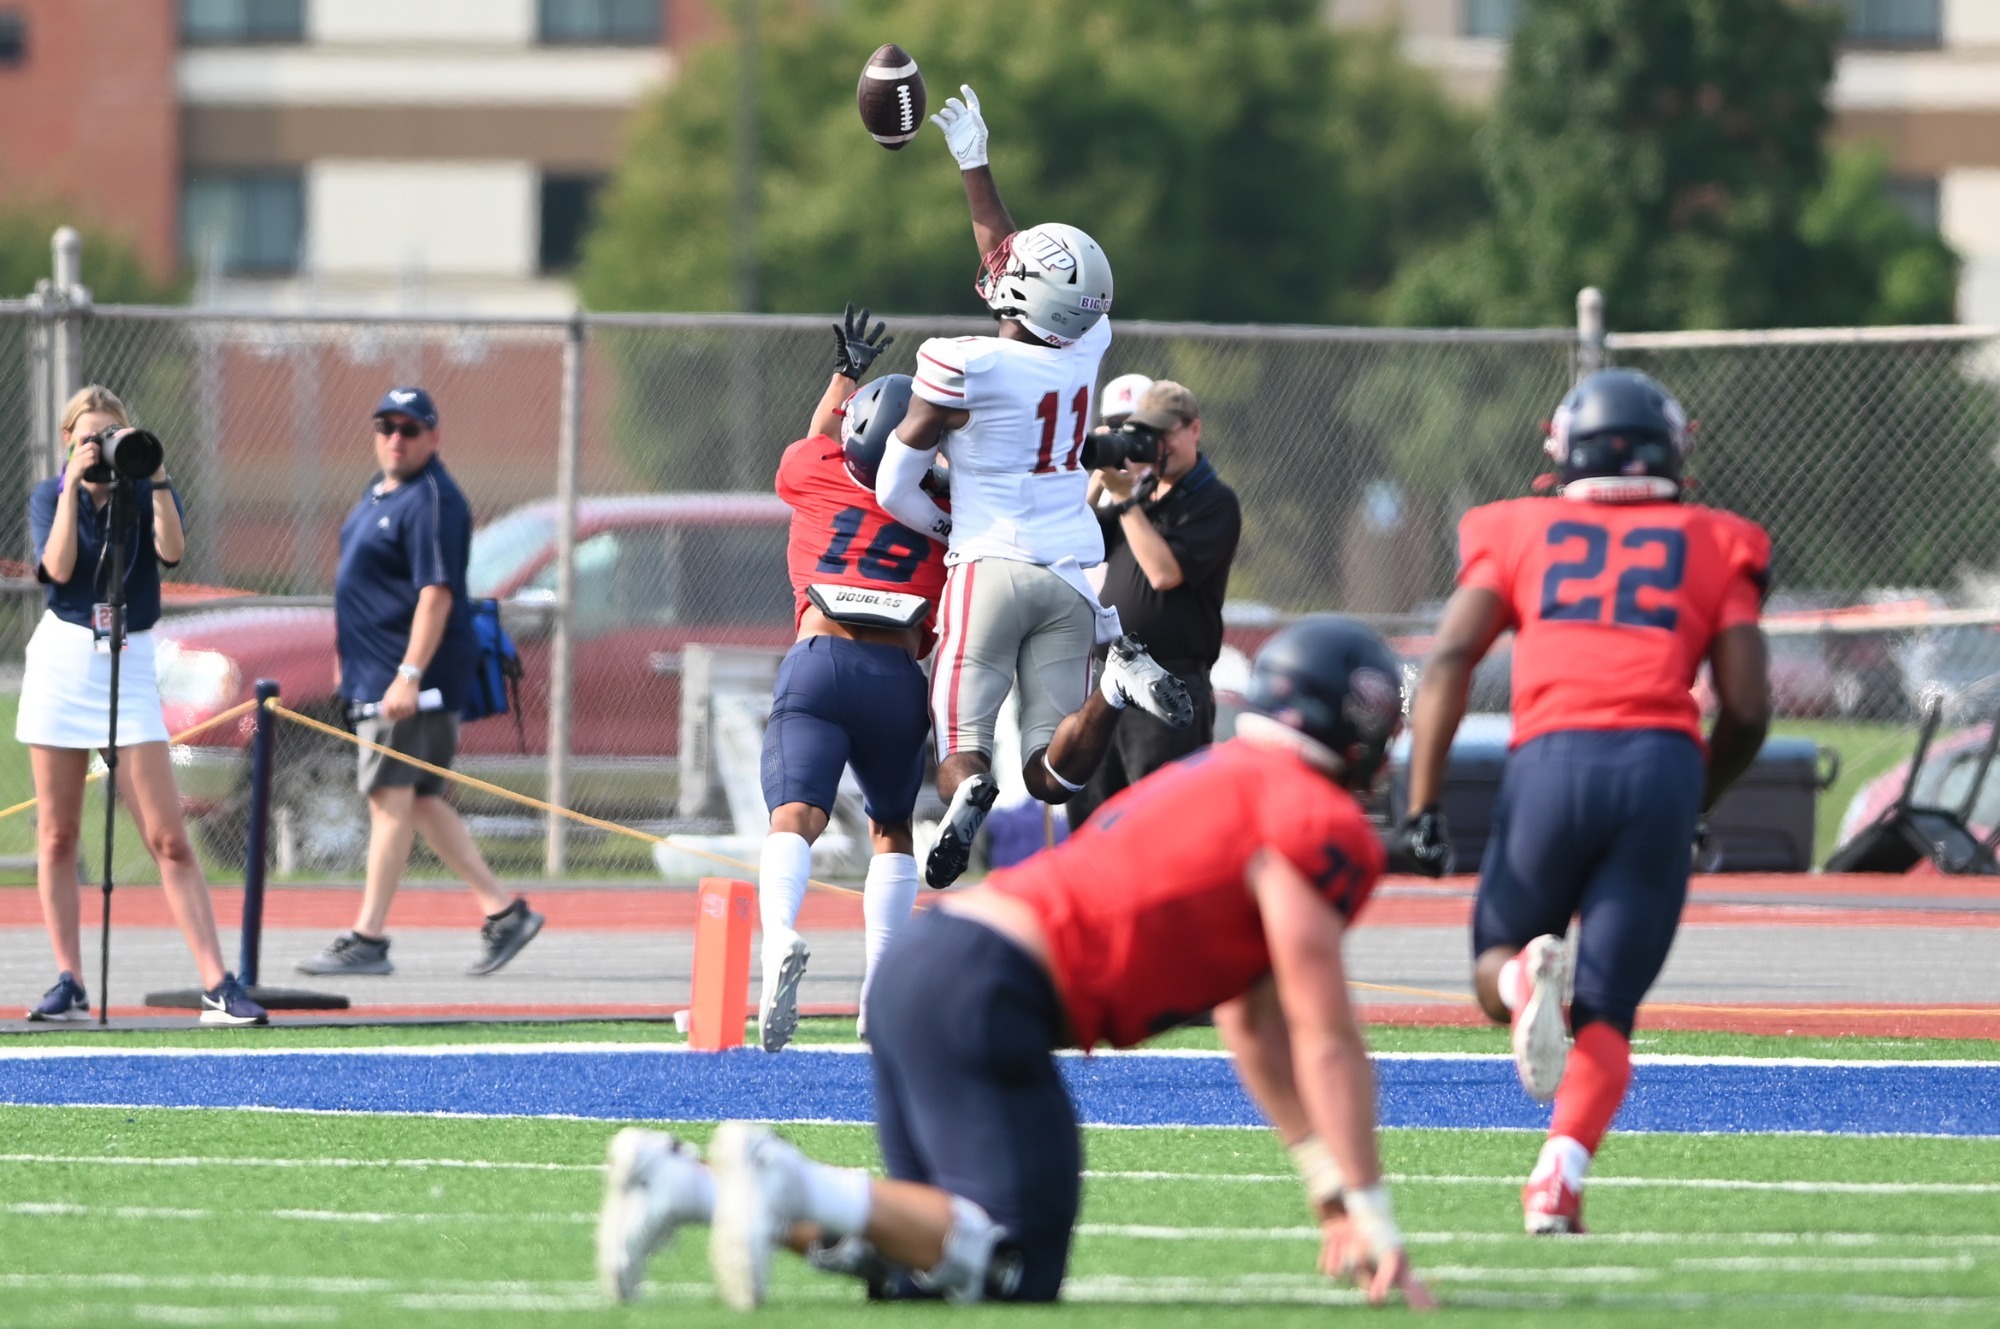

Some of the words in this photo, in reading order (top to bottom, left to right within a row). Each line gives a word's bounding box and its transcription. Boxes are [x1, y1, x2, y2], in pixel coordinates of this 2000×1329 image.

[1028, 384, 1088, 475] 11
[816, 506, 932, 583] 18
[1540, 520, 1688, 632] 22
[835, 591, 903, 608] DOUGLAS
